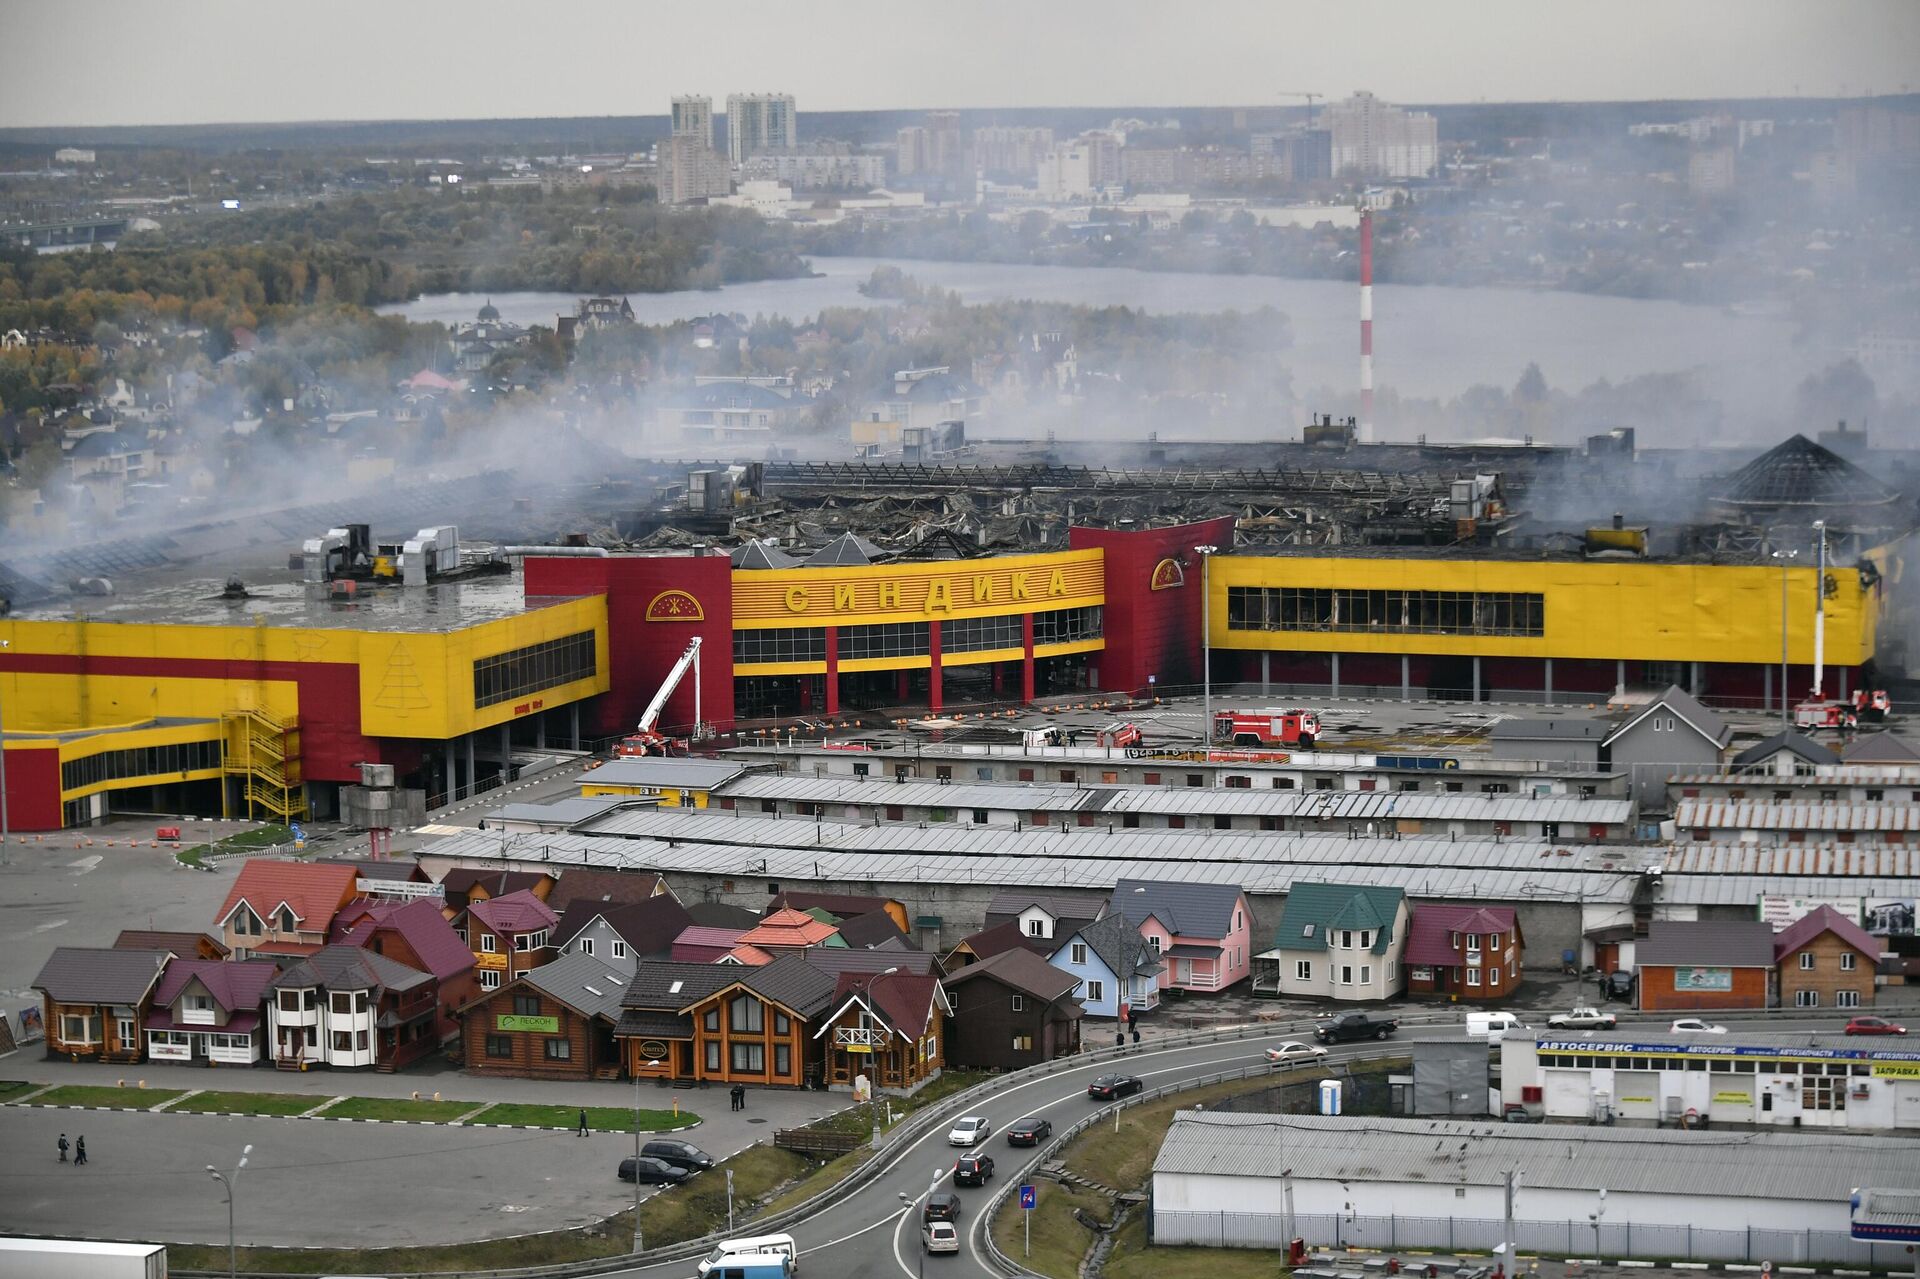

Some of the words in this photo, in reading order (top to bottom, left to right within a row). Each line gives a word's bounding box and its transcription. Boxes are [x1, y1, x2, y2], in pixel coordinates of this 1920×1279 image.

[785, 570, 1067, 614] СИНДИКА
[1540, 1042, 1633, 1052] АВТОСЕРВИС
[1687, 1046, 1736, 1054] АВТОСЕРВИС
[1779, 1049, 1834, 1057] АВТОЗАПЧАСТИ
[1876, 1067, 1919, 1075] ЗАПРАВКА
